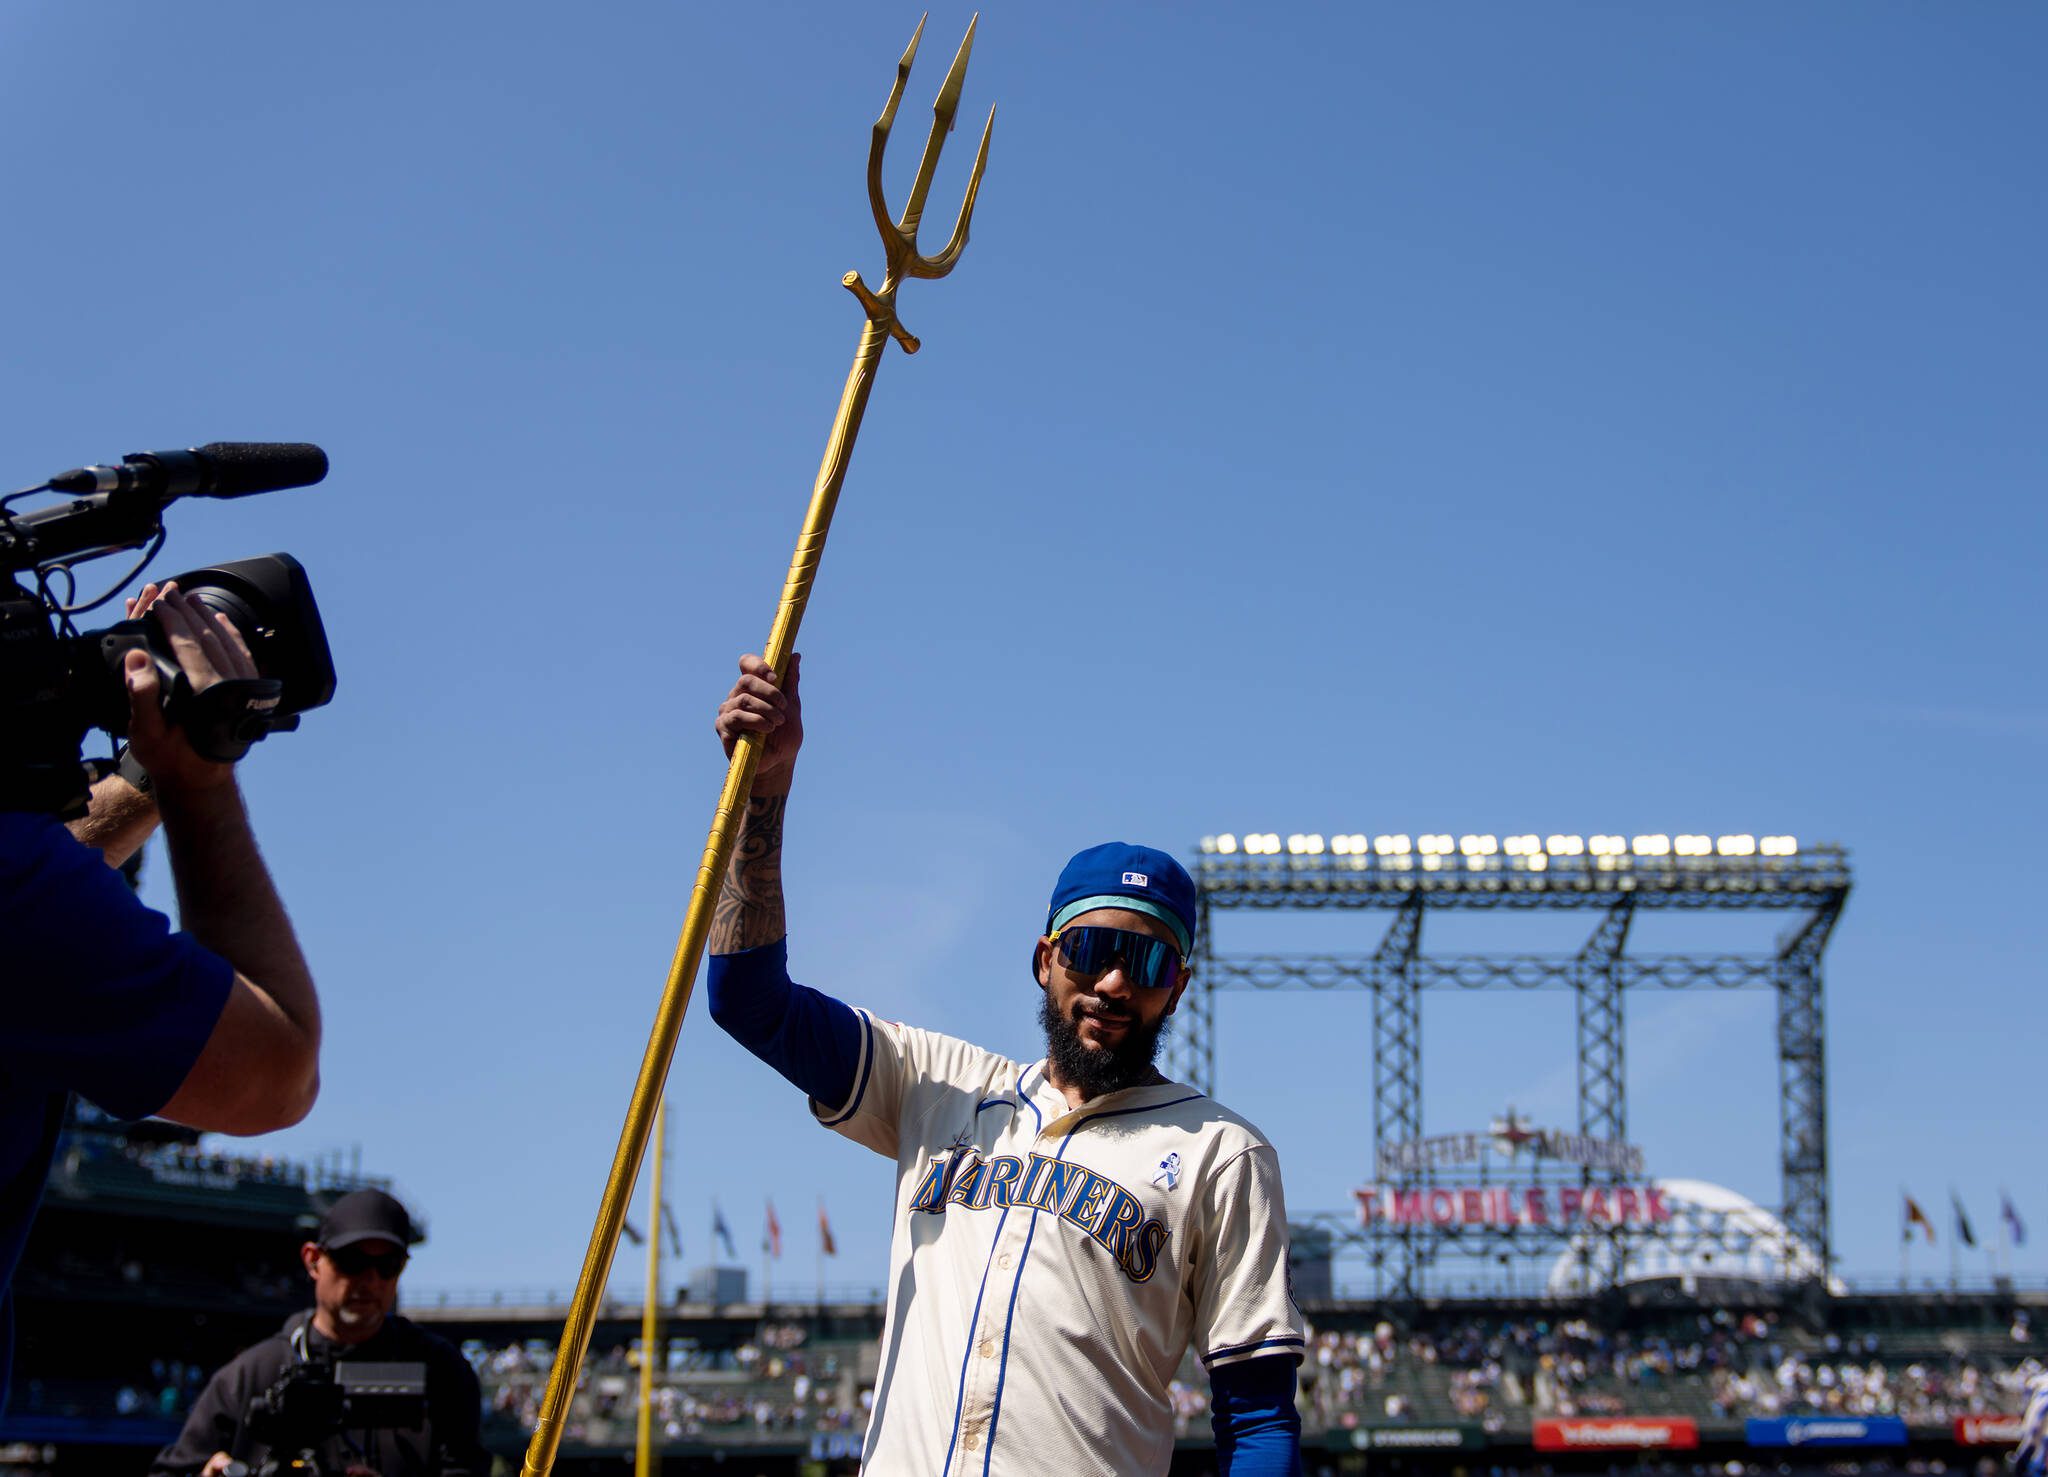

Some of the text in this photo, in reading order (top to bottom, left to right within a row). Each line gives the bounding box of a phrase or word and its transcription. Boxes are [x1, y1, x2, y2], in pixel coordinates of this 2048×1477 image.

[909, 1146, 1172, 1284] MARINERS
[1354, 1187, 1671, 1227] T-MOBILE PARK
